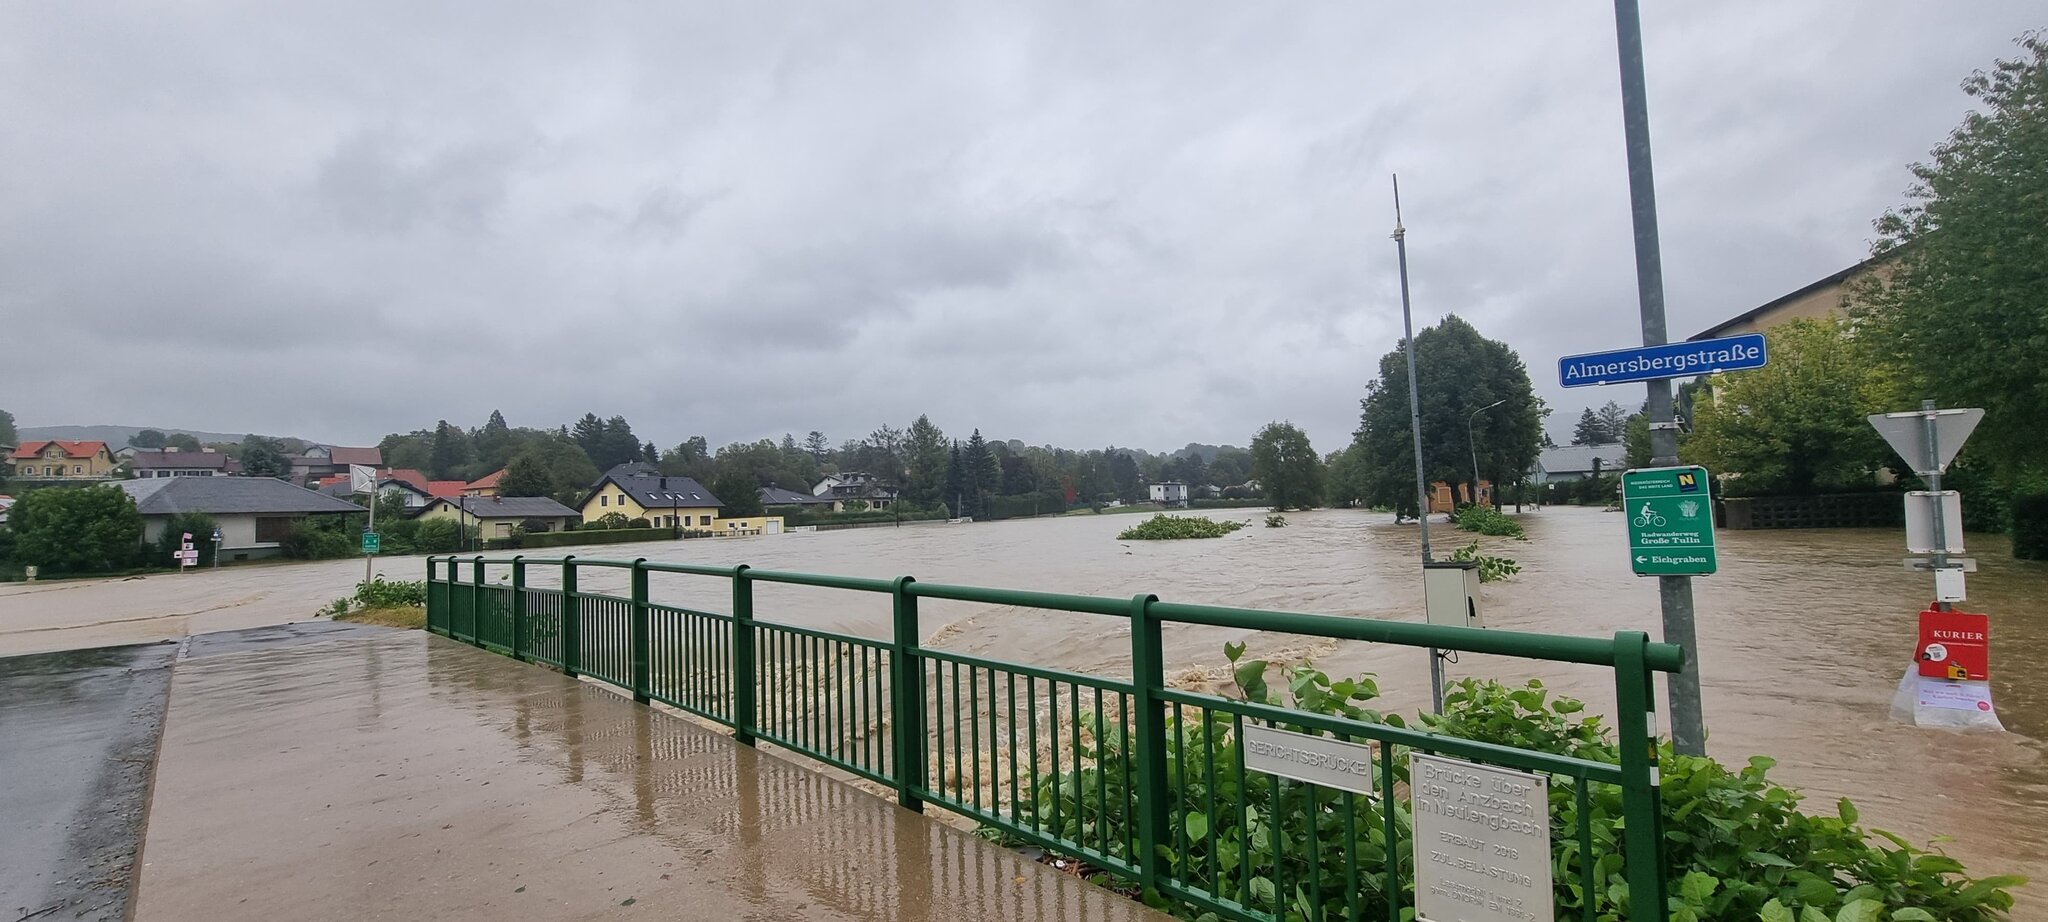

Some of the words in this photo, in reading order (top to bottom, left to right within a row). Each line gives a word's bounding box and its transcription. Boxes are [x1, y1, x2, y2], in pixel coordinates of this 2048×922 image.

[1565, 344, 1759, 379] Almersbergstraße
[1652, 556, 1707, 564] Eichgraben
[1933, 630, 1984, 640] KURIER
[1249, 739, 1367, 776] GERICHTSBRÜCKE
[1423, 763, 1481, 788] Brücke
[1492, 776, 1530, 797] über
[1422, 780, 1449, 800] den
[1458, 787, 1534, 817] Anzbach
[1416, 795, 1430, 812] in
[1434, 798, 1543, 838] Neulengbach
[1439, 830, 1485, 851] ERBAUT
[1430, 850, 1532, 888] ZUL.BELASTUNG
